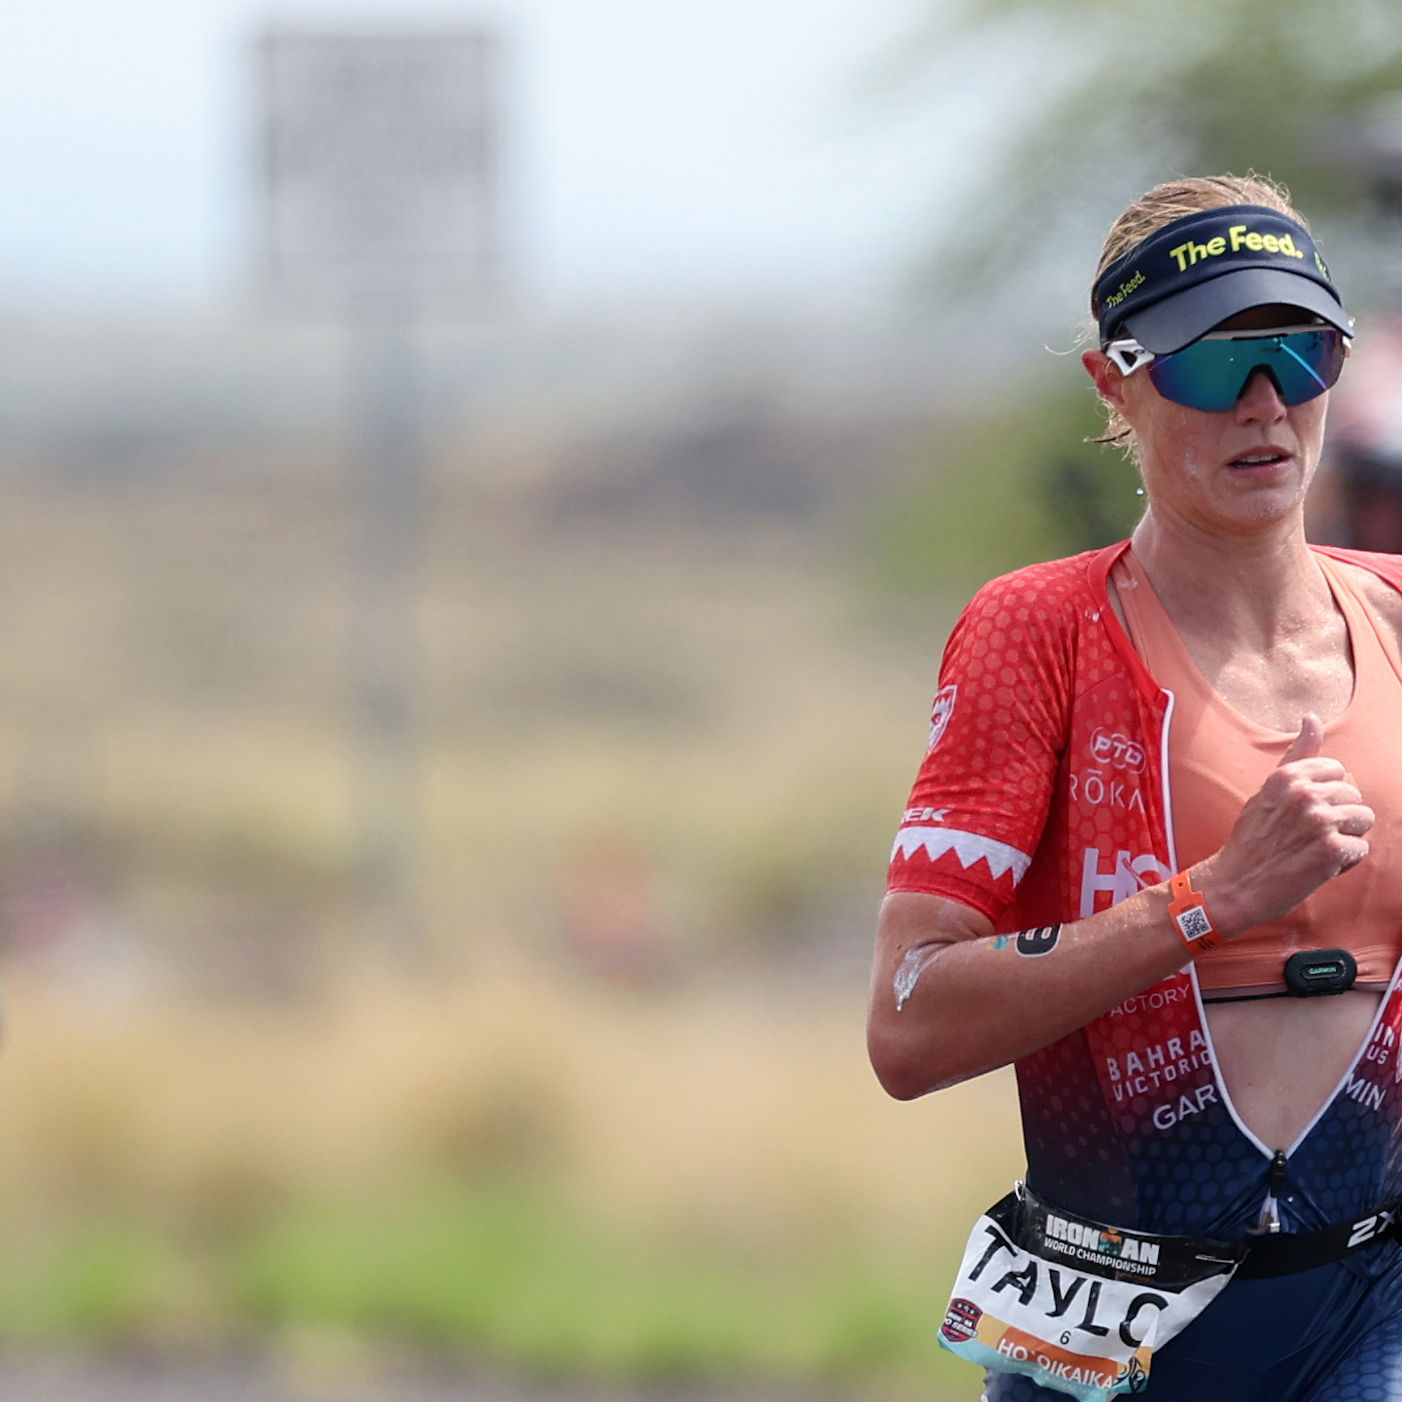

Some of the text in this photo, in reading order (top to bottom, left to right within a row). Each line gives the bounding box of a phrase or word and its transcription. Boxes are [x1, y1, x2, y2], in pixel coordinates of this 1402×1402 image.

[1169, 225, 1304, 272] The Feed.
[1092, 731, 1144, 769] PTO
[901, 807, 951, 824] EK
[1106, 1029, 1207, 1082] BAHRA
[1153, 1083, 1218, 1130] GAR
[1044, 1237, 1076, 1256] WORLD
[1076, 1248, 1157, 1277] CHAMPIONSHIP
[1059, 1330, 1072, 1345] 6
